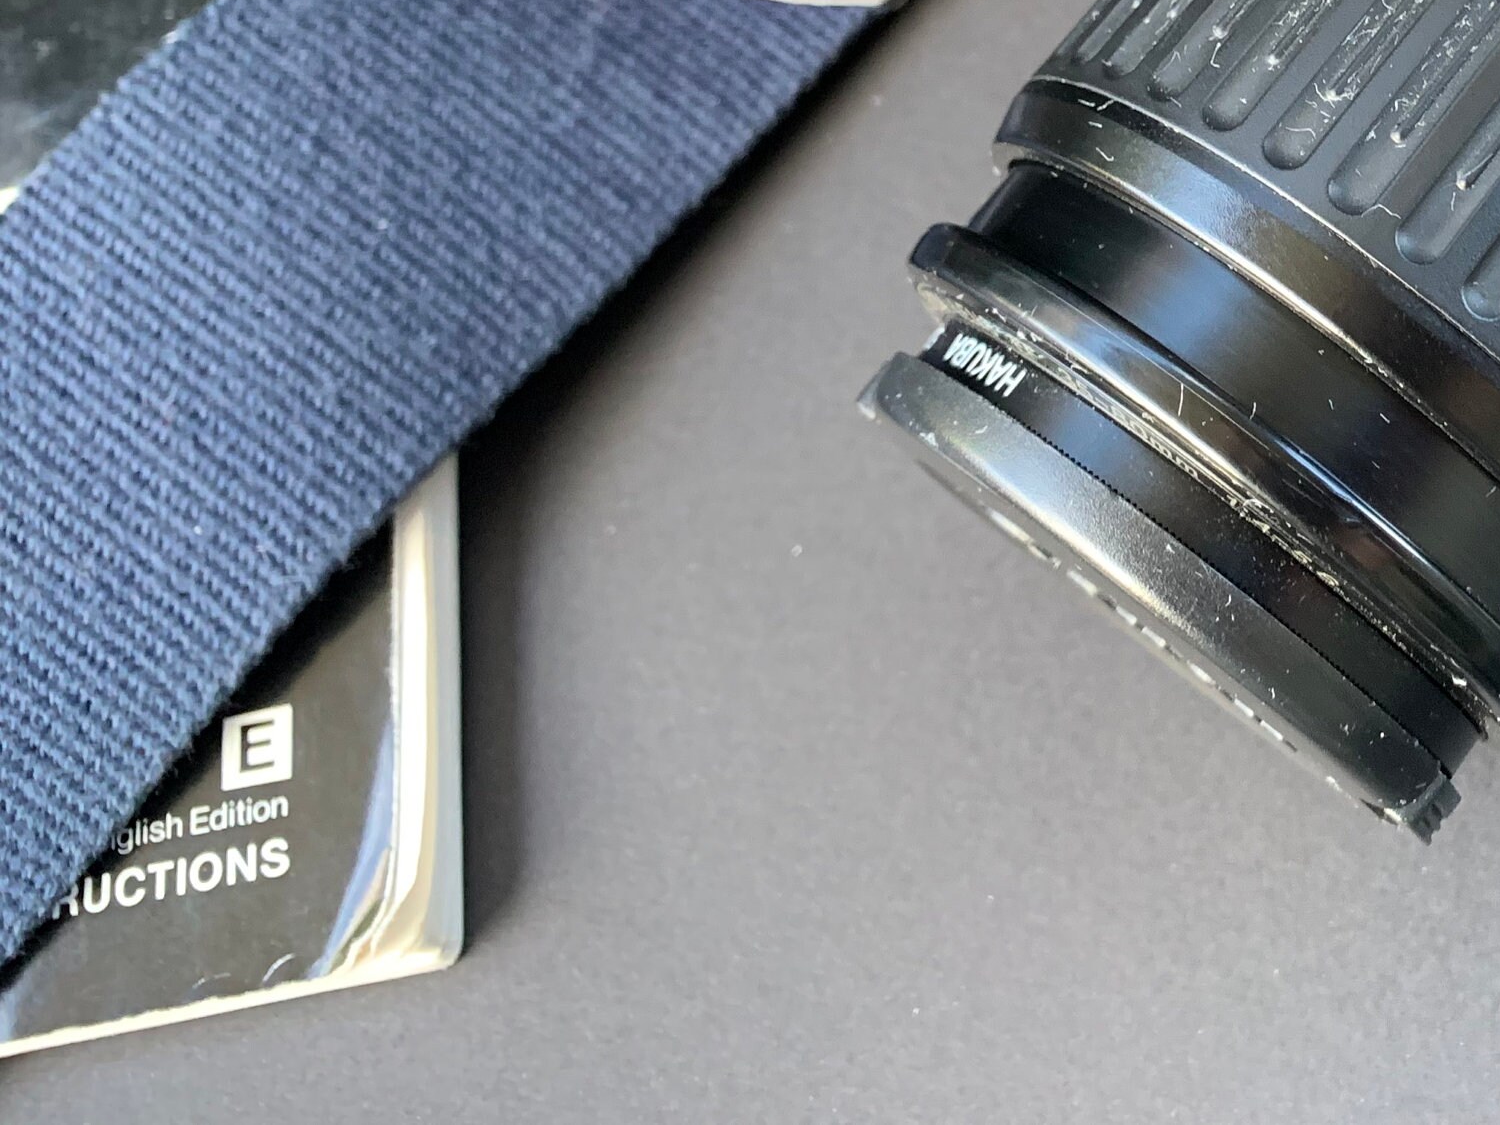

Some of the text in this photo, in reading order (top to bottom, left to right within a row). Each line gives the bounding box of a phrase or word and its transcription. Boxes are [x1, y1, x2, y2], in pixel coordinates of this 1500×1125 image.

[942, 333, 1028, 398] HAKUBA
[240, 719, 276, 773] E
[189, 795, 290, 836] Edition
